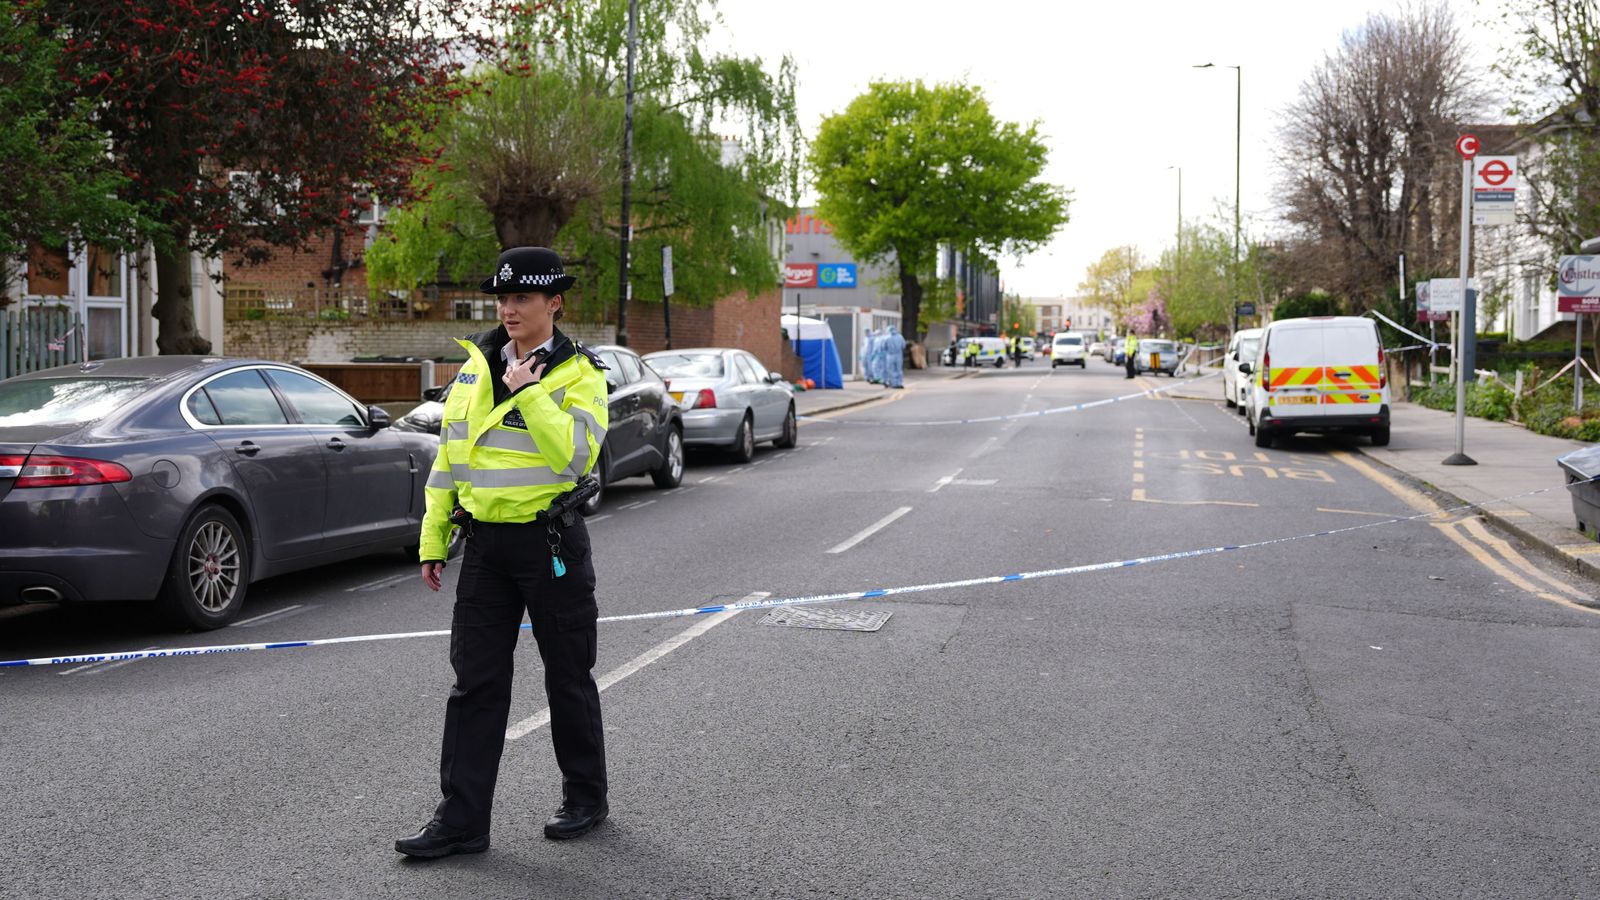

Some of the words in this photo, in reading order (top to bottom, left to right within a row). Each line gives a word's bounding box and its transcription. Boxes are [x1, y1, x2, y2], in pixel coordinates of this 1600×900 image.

[1461, 137, 1475, 154] C
[785, 267, 814, 279] Argos
[1181, 463, 1336, 483] BUS
